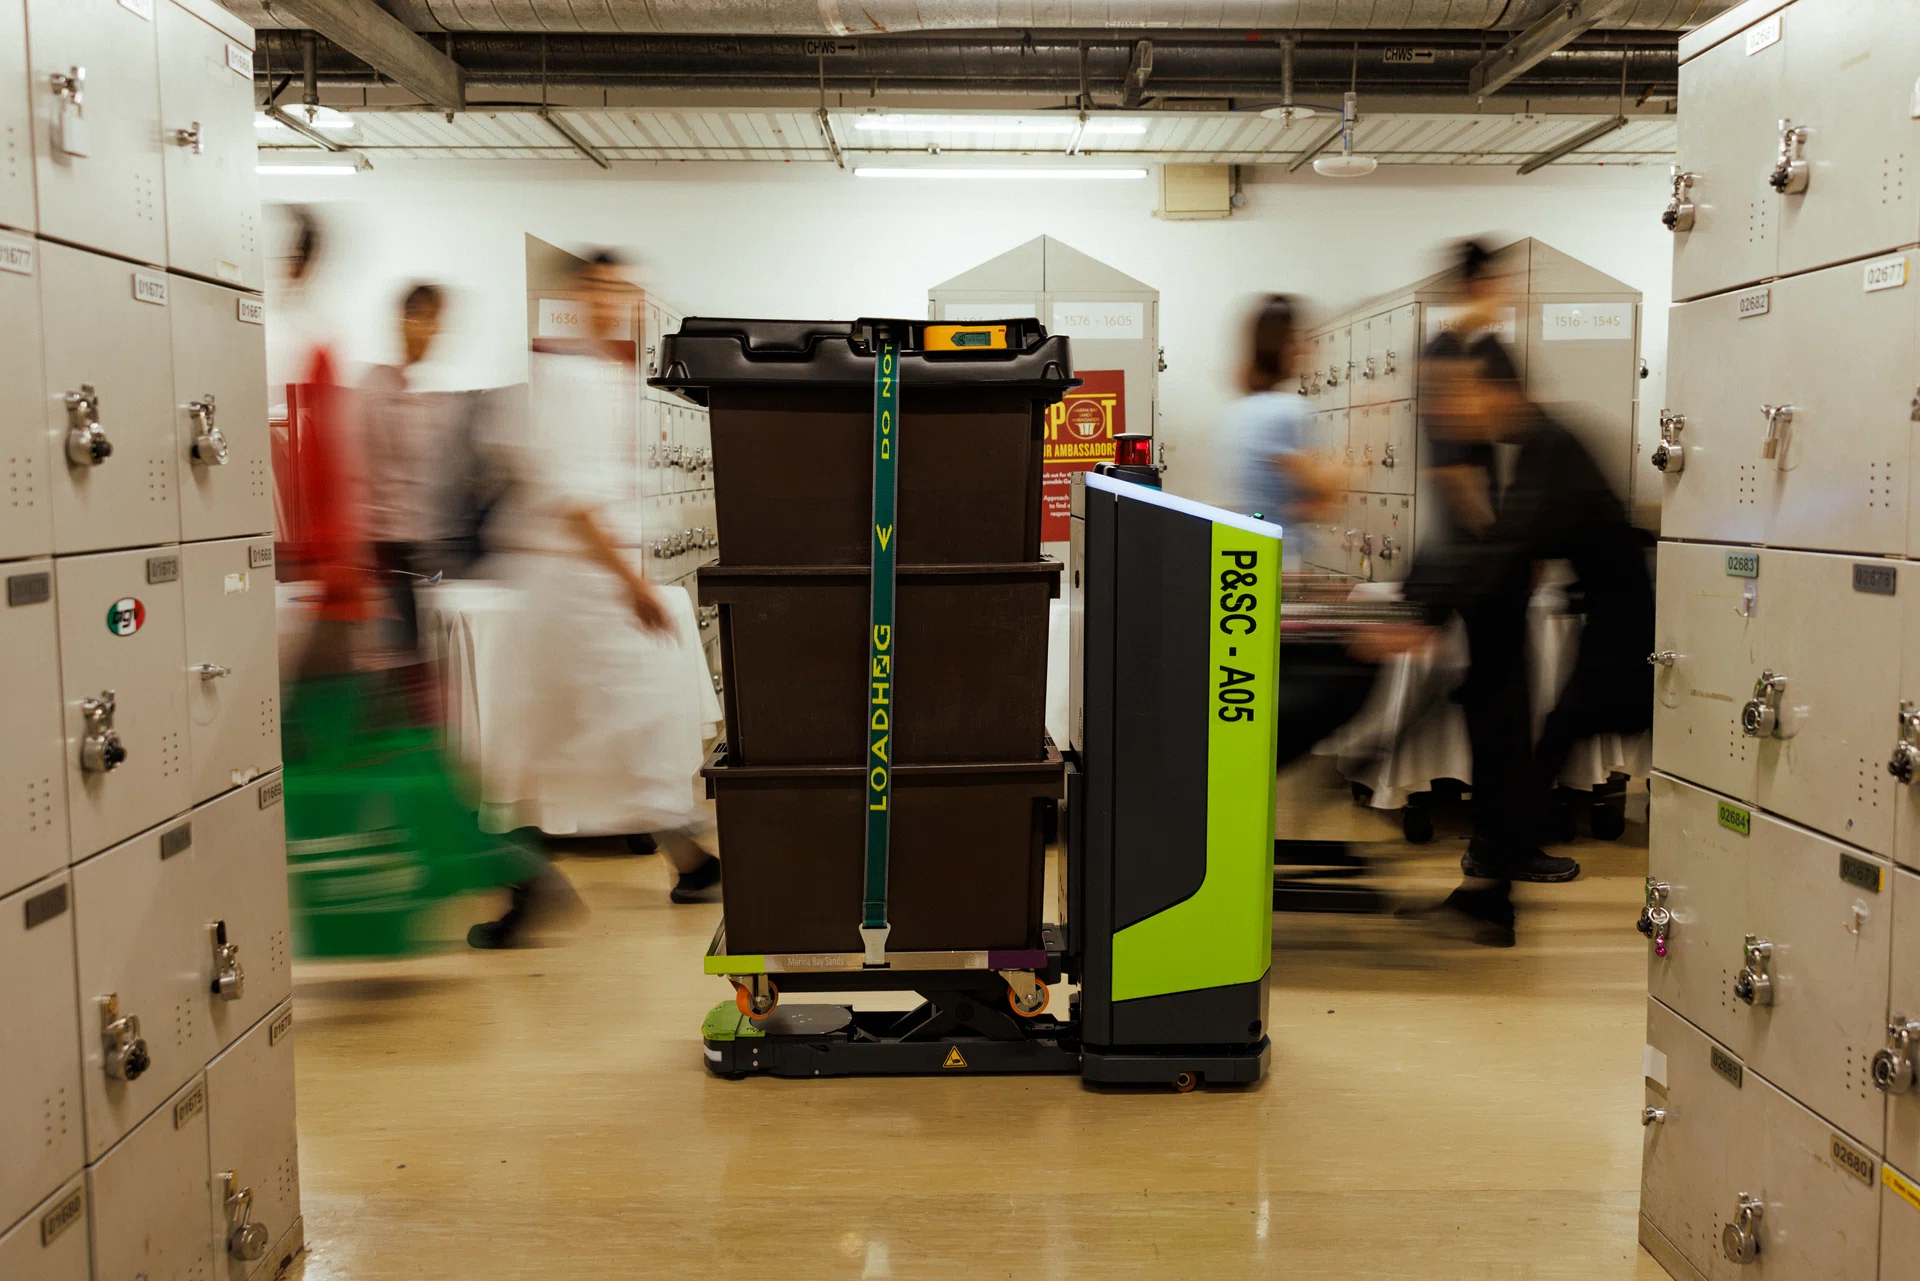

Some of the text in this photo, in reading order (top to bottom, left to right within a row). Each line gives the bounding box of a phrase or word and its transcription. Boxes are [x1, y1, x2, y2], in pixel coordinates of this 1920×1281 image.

[808, 41, 835, 53] CHWS
[1385, 48, 1412, 61] CHWS
[1867, 263, 1902, 284] 02677
[139, 280, 165, 299] 01672
[242, 304, 262, 319] 01667
[1740, 295, 1765, 312] 02682
[551, 313, 578, 325] 1636
[1064, 315, 1090, 327] 1576
[1104, 315, 1132, 327] 1605
[1555, 315, 1580, 327] 1516
[1593, 315, 1620, 327] 1545
[881, 343, 893, 459] DO NOT
[253, 548, 272, 562] 01668
[1728, 556, 1754, 571] 02683
[1220, 551, 1258, 635] P&SC
[1218, 665, 1256, 722] A05
[263, 783, 282, 803] 01669
[1720, 806, 1746, 829] 02684
[274, 1013, 291, 1038] 01670
[1712, 1052, 1738, 1081] 02685
[179, 1088, 203, 1120] 01675
[1833, 1141, 1868, 1178] 02680
